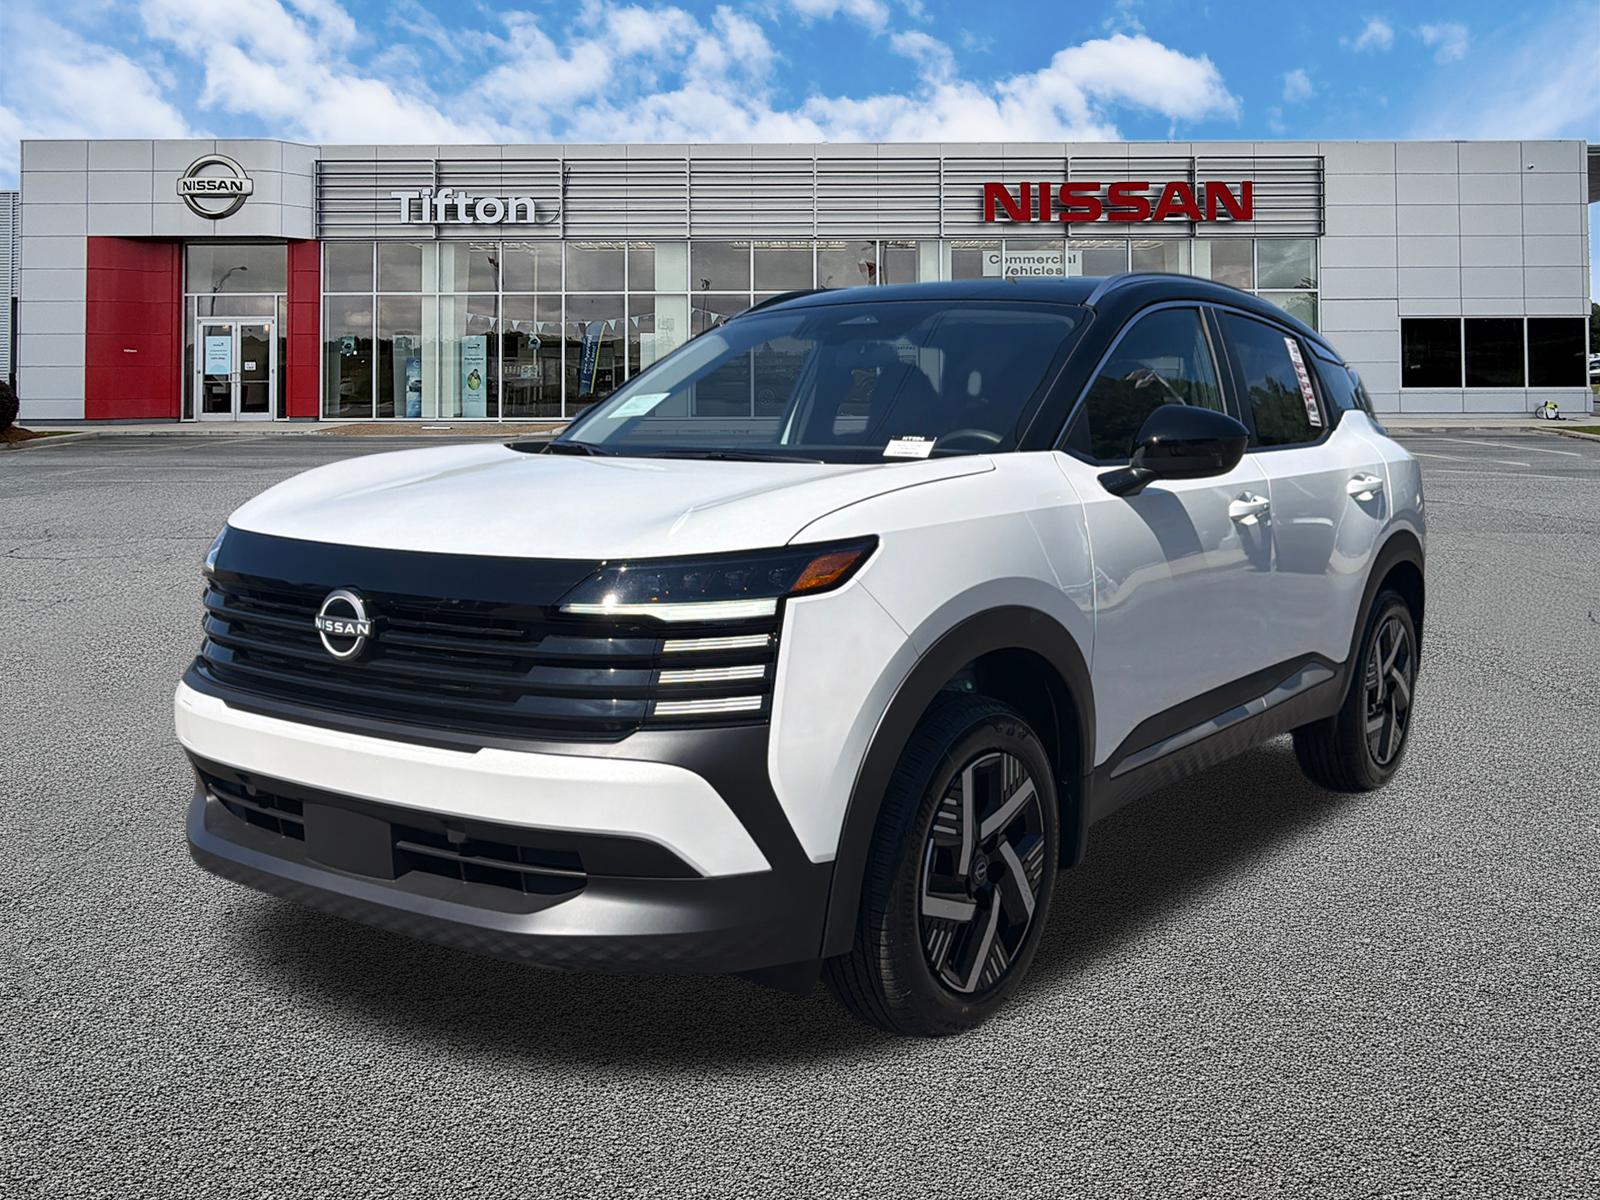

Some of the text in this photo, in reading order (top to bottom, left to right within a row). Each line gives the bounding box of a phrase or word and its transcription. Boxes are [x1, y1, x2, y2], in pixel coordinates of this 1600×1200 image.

[183, 180, 243, 191] NISSAN
[391, 188, 536, 224] Tifton
[983, 181, 1253, 222] NISSAN
[315, 617, 369, 634] NISSAN
